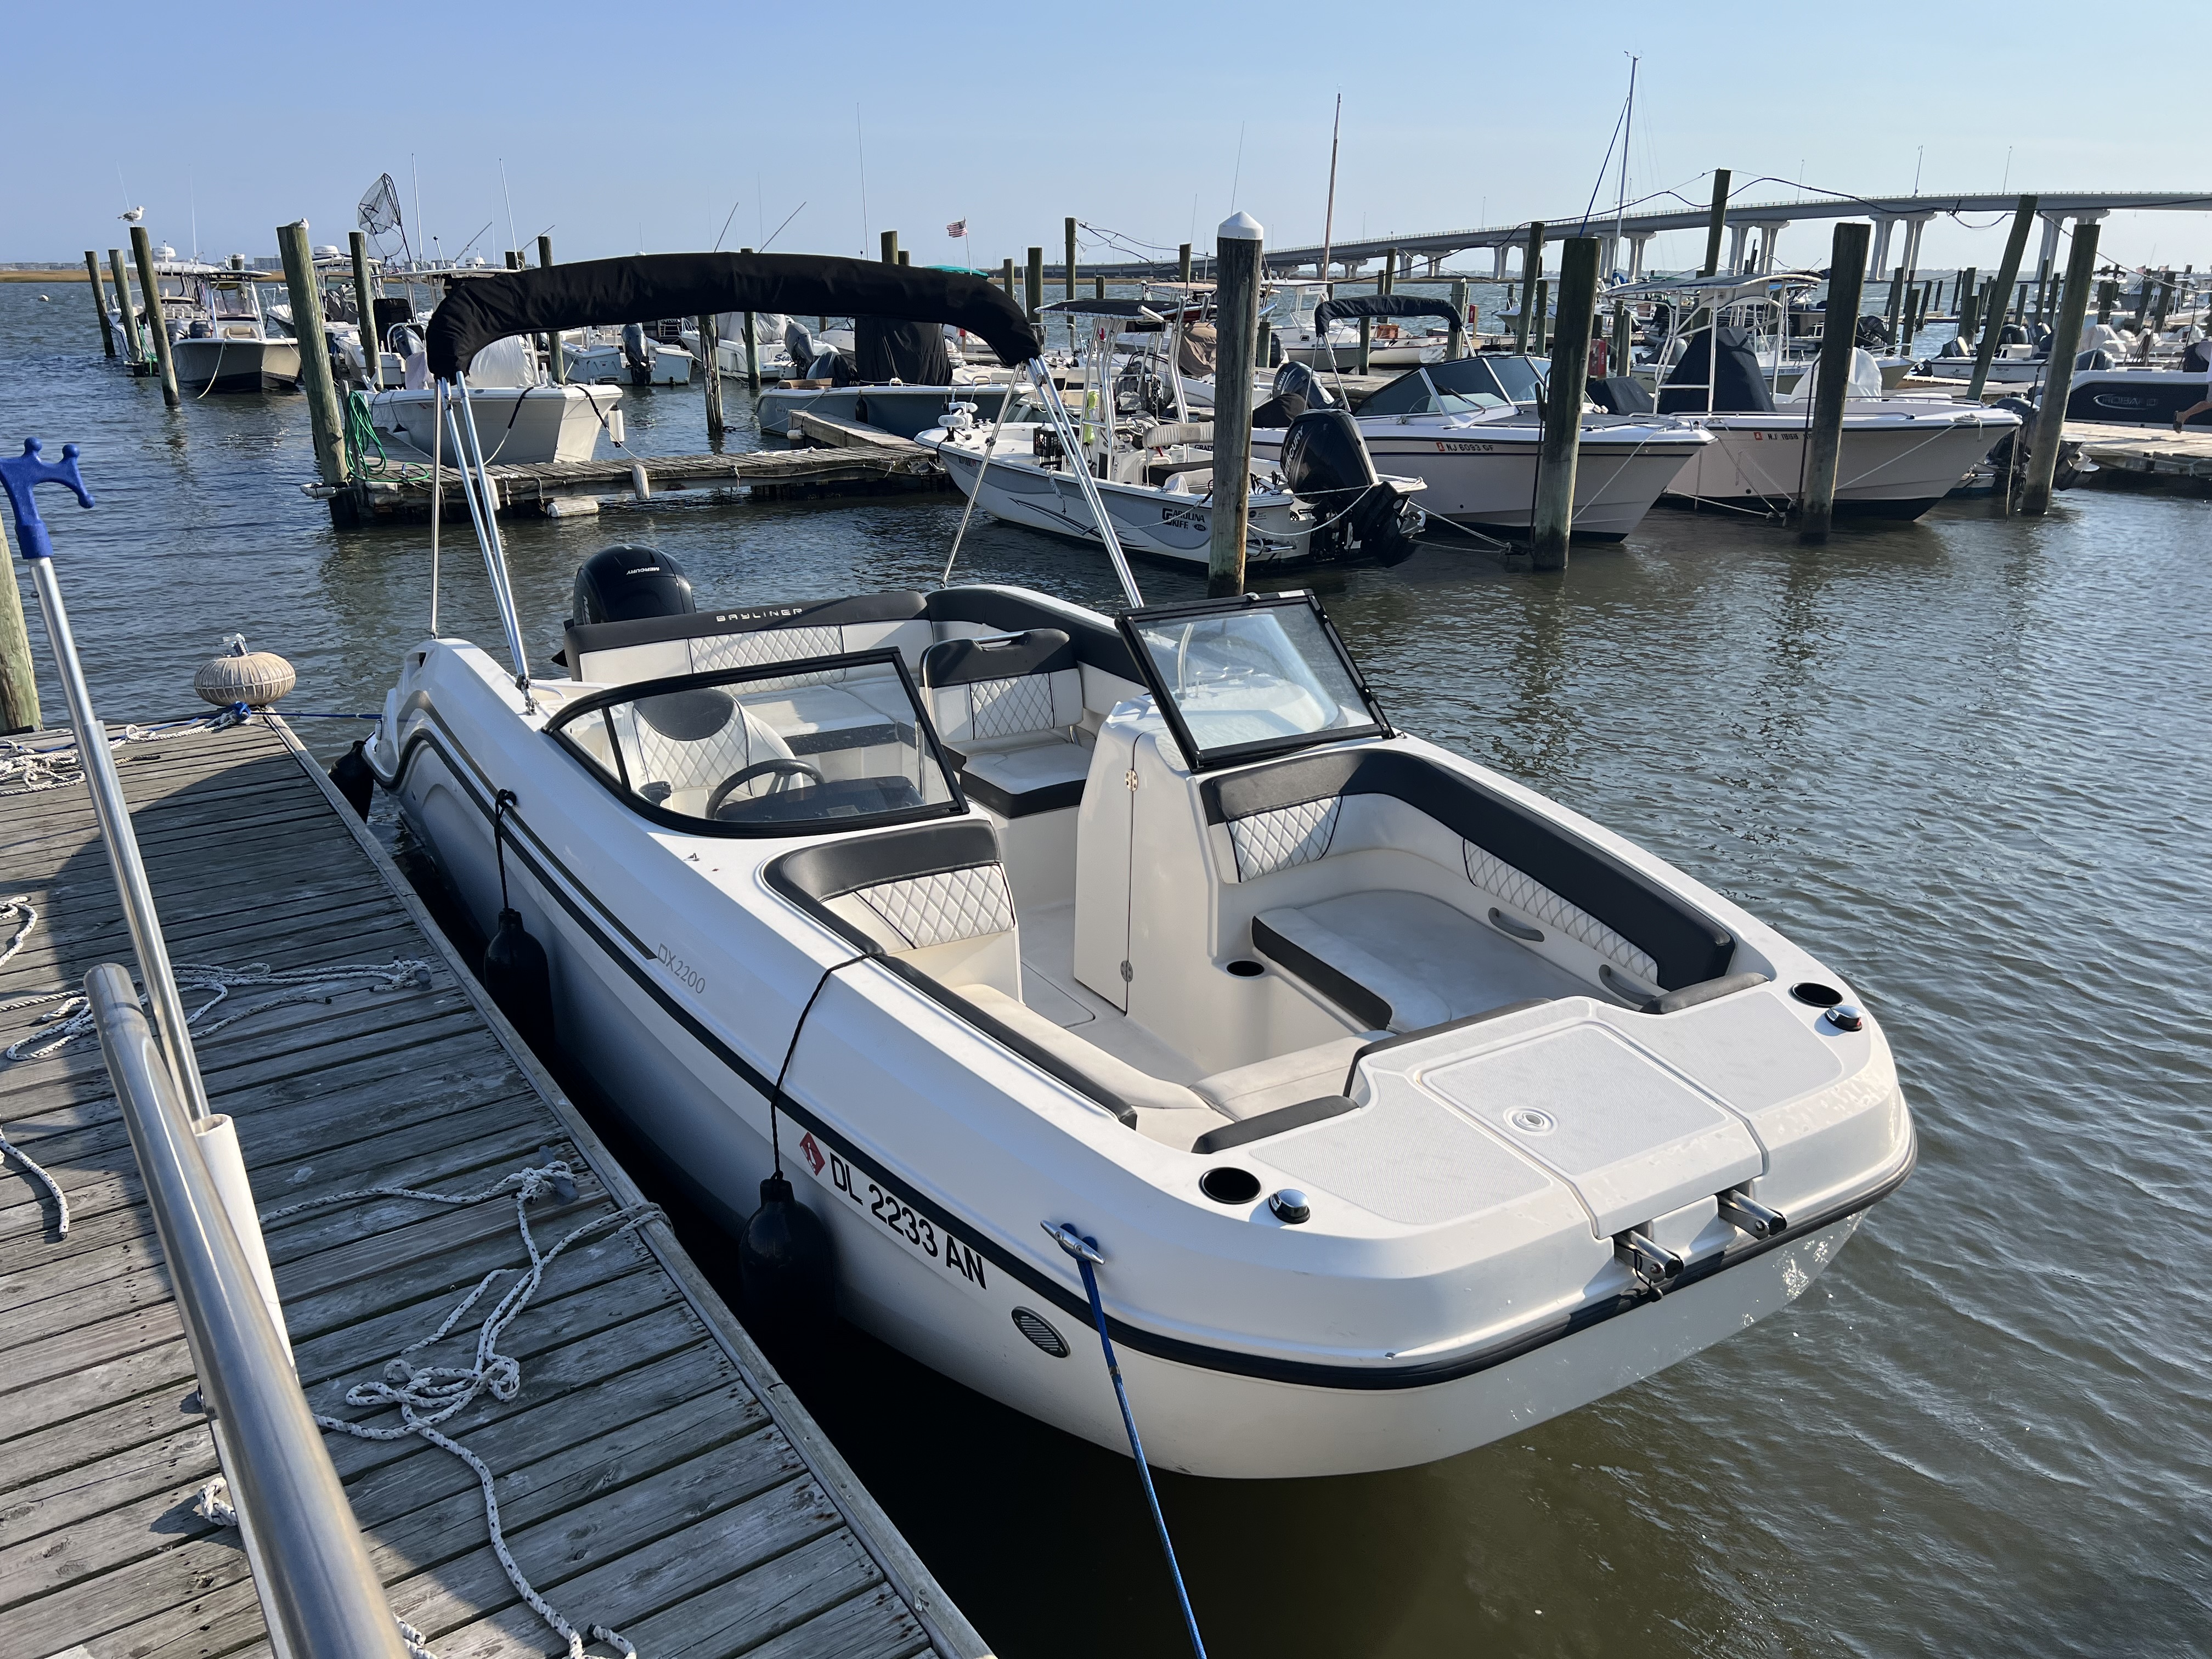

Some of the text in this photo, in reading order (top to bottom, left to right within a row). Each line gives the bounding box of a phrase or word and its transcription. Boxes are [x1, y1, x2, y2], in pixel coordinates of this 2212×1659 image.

[1277, 371, 1288, 390] YAMAHA
[2102, 396, 2158, 407] ROBAO
[626, 567, 659, 575] MERCURY
[716, 608, 803, 622] BAYLINER
[658, 943, 706, 994] DX2200
[830, 1152, 863, 1206] DL
[868, 1184, 938, 1257] 2233
[946, 1234, 987, 1290] AN
